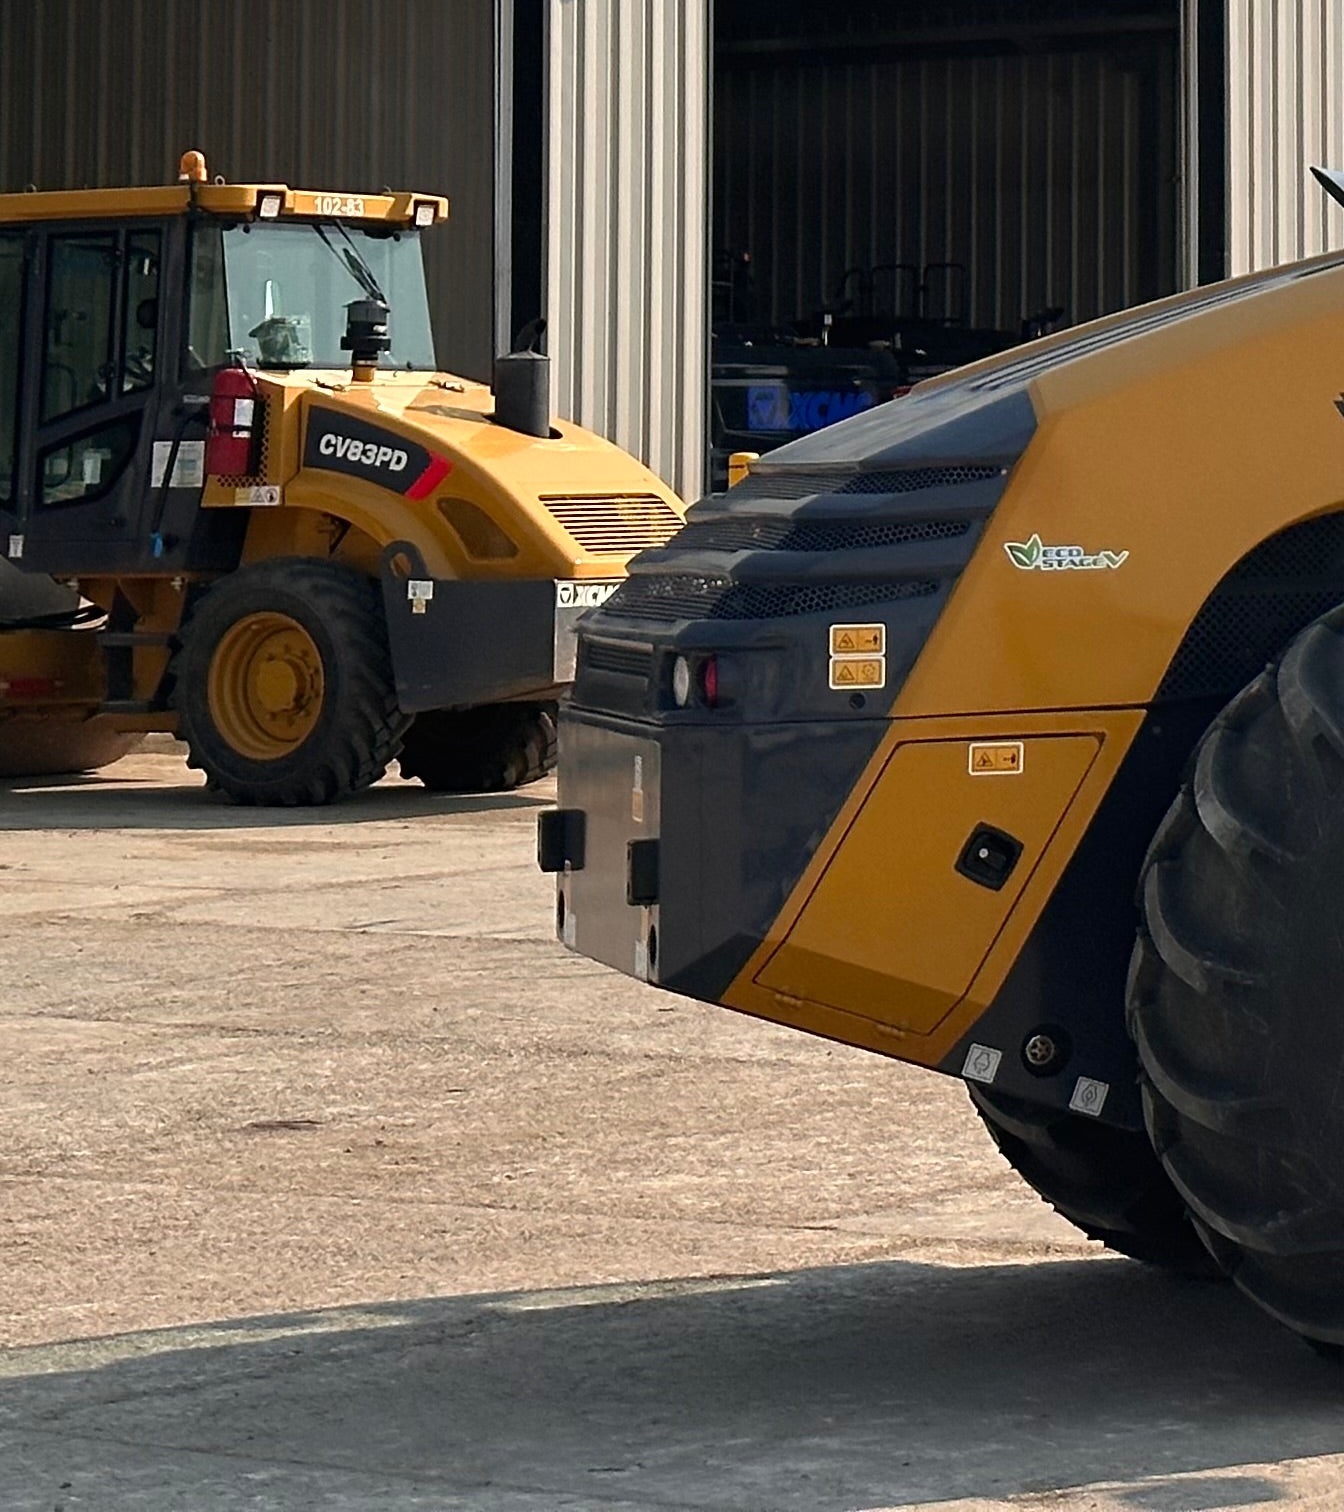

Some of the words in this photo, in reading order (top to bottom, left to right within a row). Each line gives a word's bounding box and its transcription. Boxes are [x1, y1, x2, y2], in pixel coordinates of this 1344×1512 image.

[314, 196, 364, 216] 102-83
[319, 433, 408, 471] CV83PD
[1042, 548, 1081, 558] ECO
